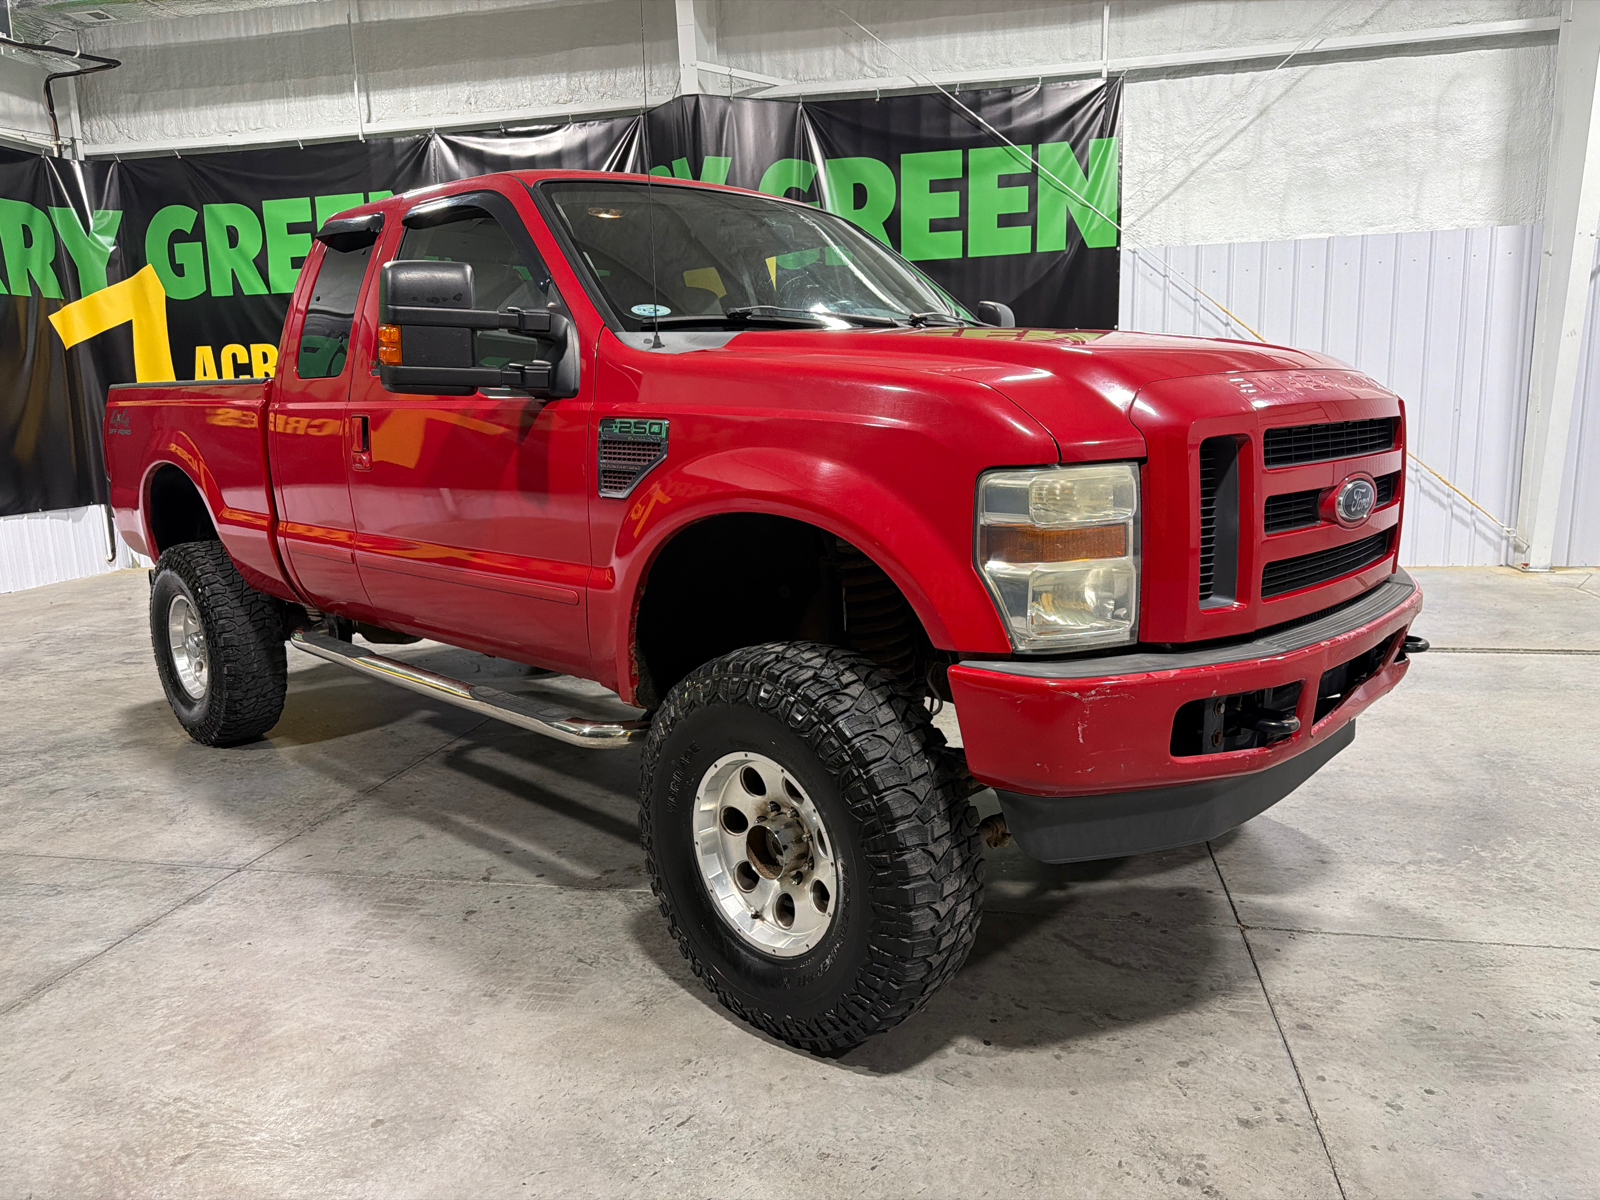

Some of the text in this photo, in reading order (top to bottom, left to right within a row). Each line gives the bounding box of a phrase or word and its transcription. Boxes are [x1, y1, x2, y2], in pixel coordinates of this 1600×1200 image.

[48, 264, 175, 382] 7
[601, 420, 663, 436] F-250
[1351, 488, 1371, 512] Ford
